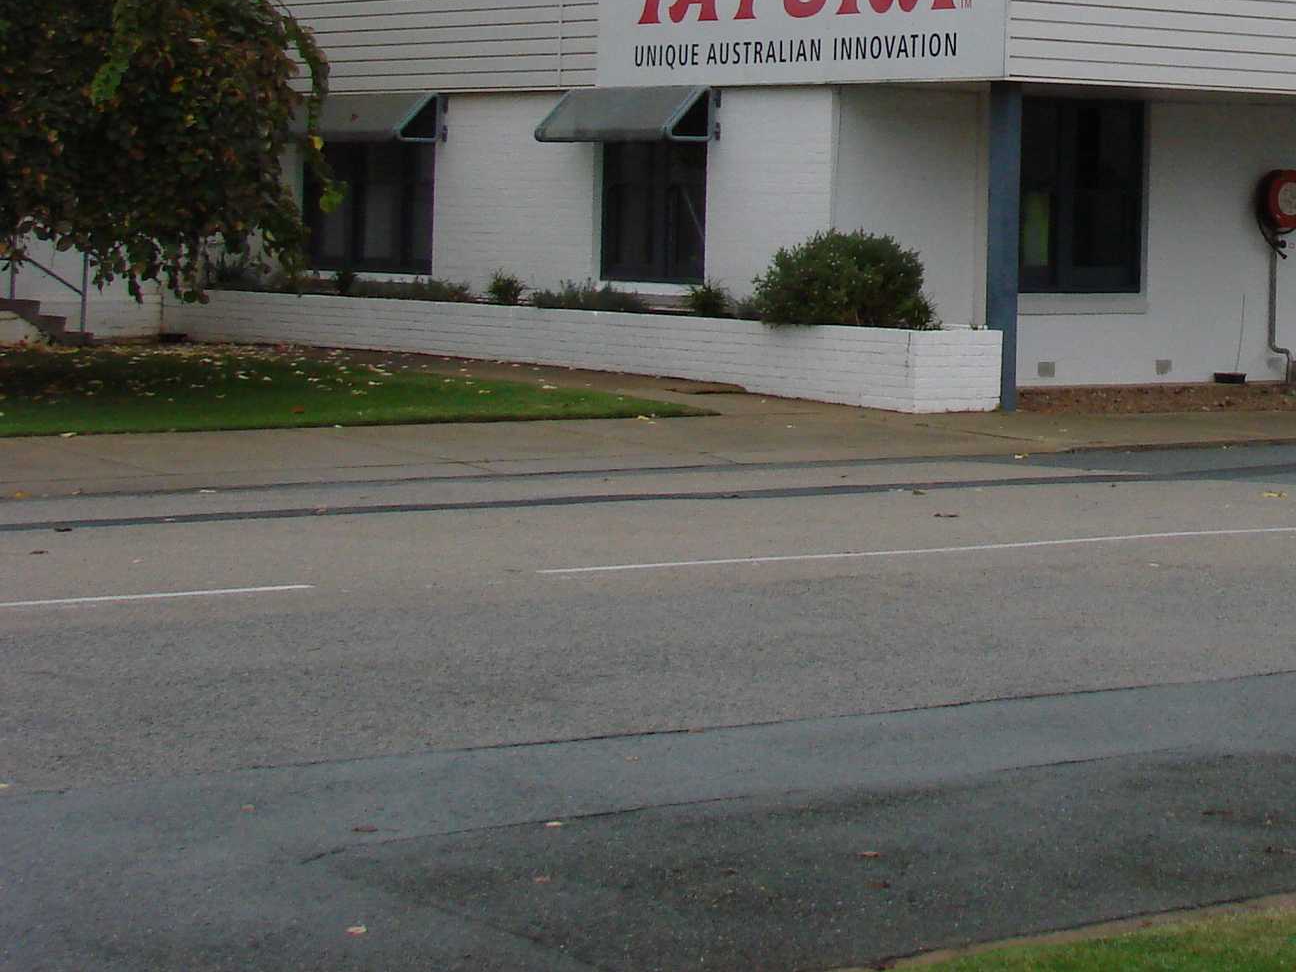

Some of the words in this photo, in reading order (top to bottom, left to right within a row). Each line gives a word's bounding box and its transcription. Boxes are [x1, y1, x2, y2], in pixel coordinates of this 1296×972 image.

[635, 43, 699, 70] UNIQUE
[707, 38, 822, 65] AUSTRALIAN
[833, 32, 958, 61] INNOVATION
